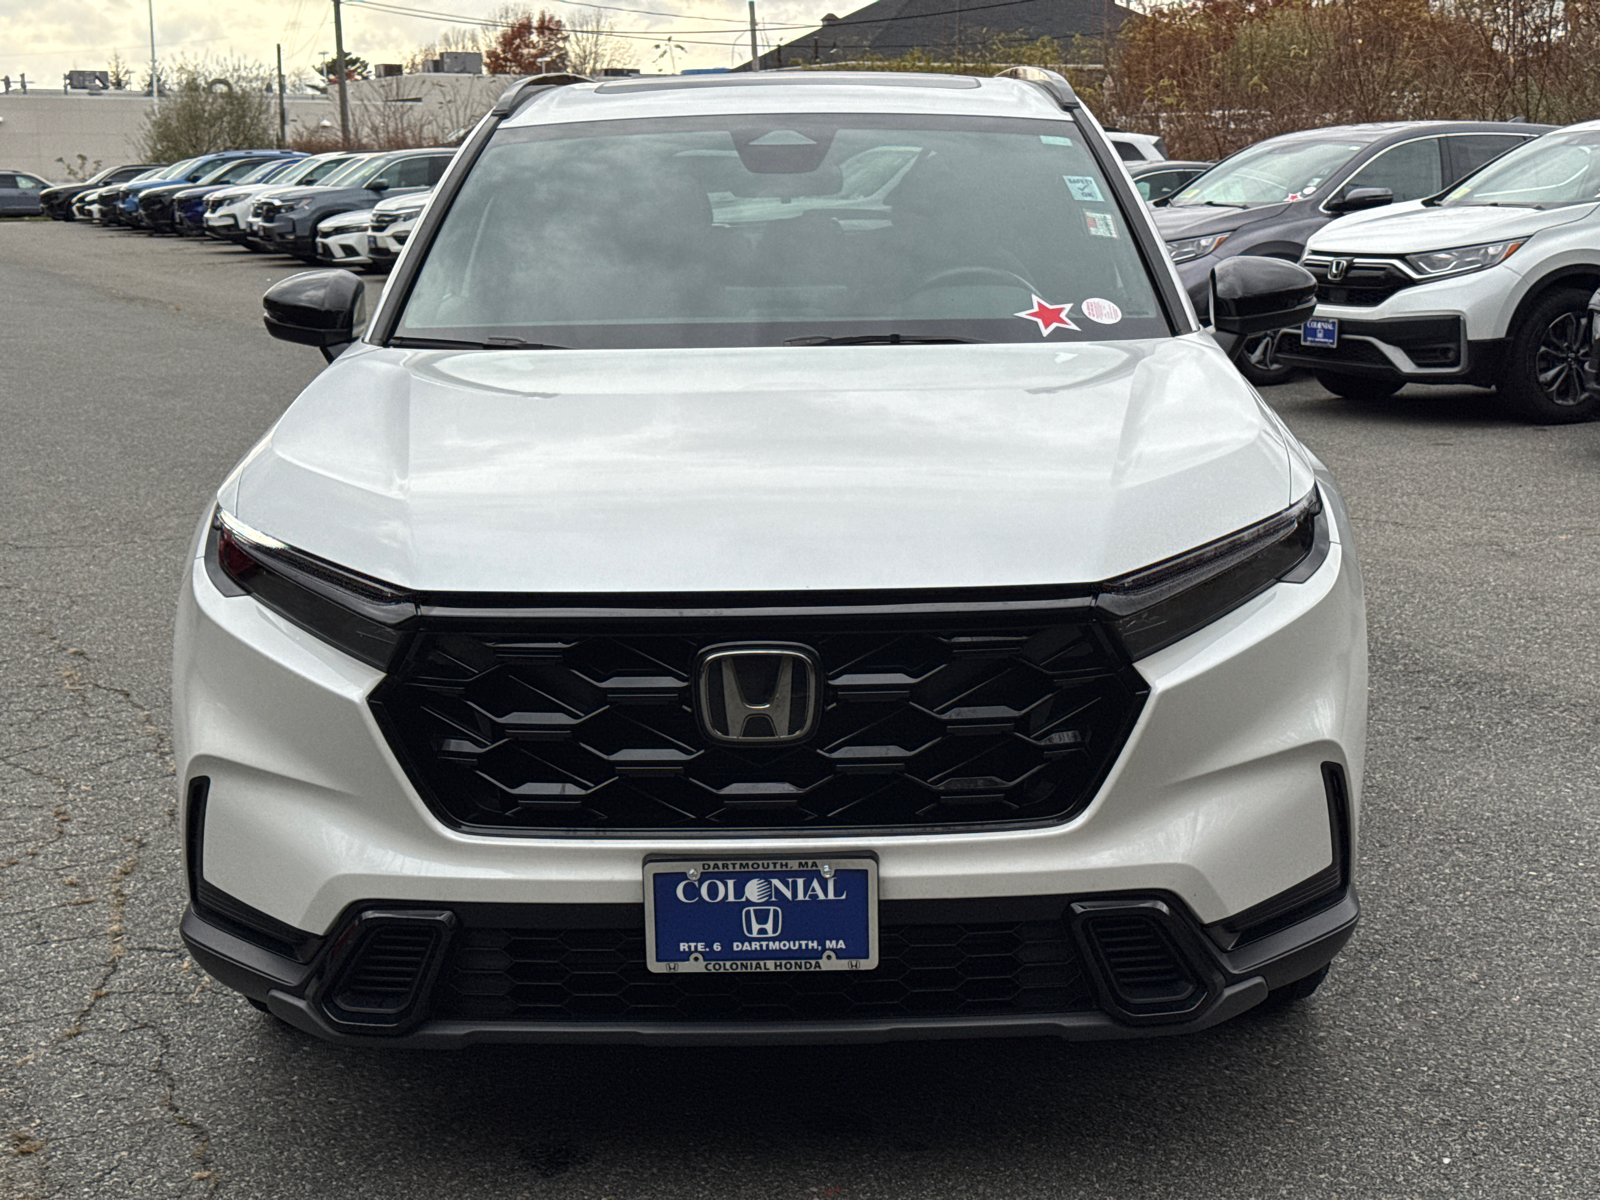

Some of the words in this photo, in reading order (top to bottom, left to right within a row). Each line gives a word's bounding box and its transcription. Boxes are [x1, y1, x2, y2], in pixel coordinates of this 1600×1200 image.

[797, 861, 819, 870] MA
[675, 877, 847, 904] COLONIAL
[679, 942, 710, 952] RTE.
[712, 942, 722, 952] 6
[732, 940, 822, 951] DARTMOUTH,
[825, 939, 846, 950] MA
[704, 961, 770, 972] COLONIAL
[773, 960, 822, 971] HONDA
